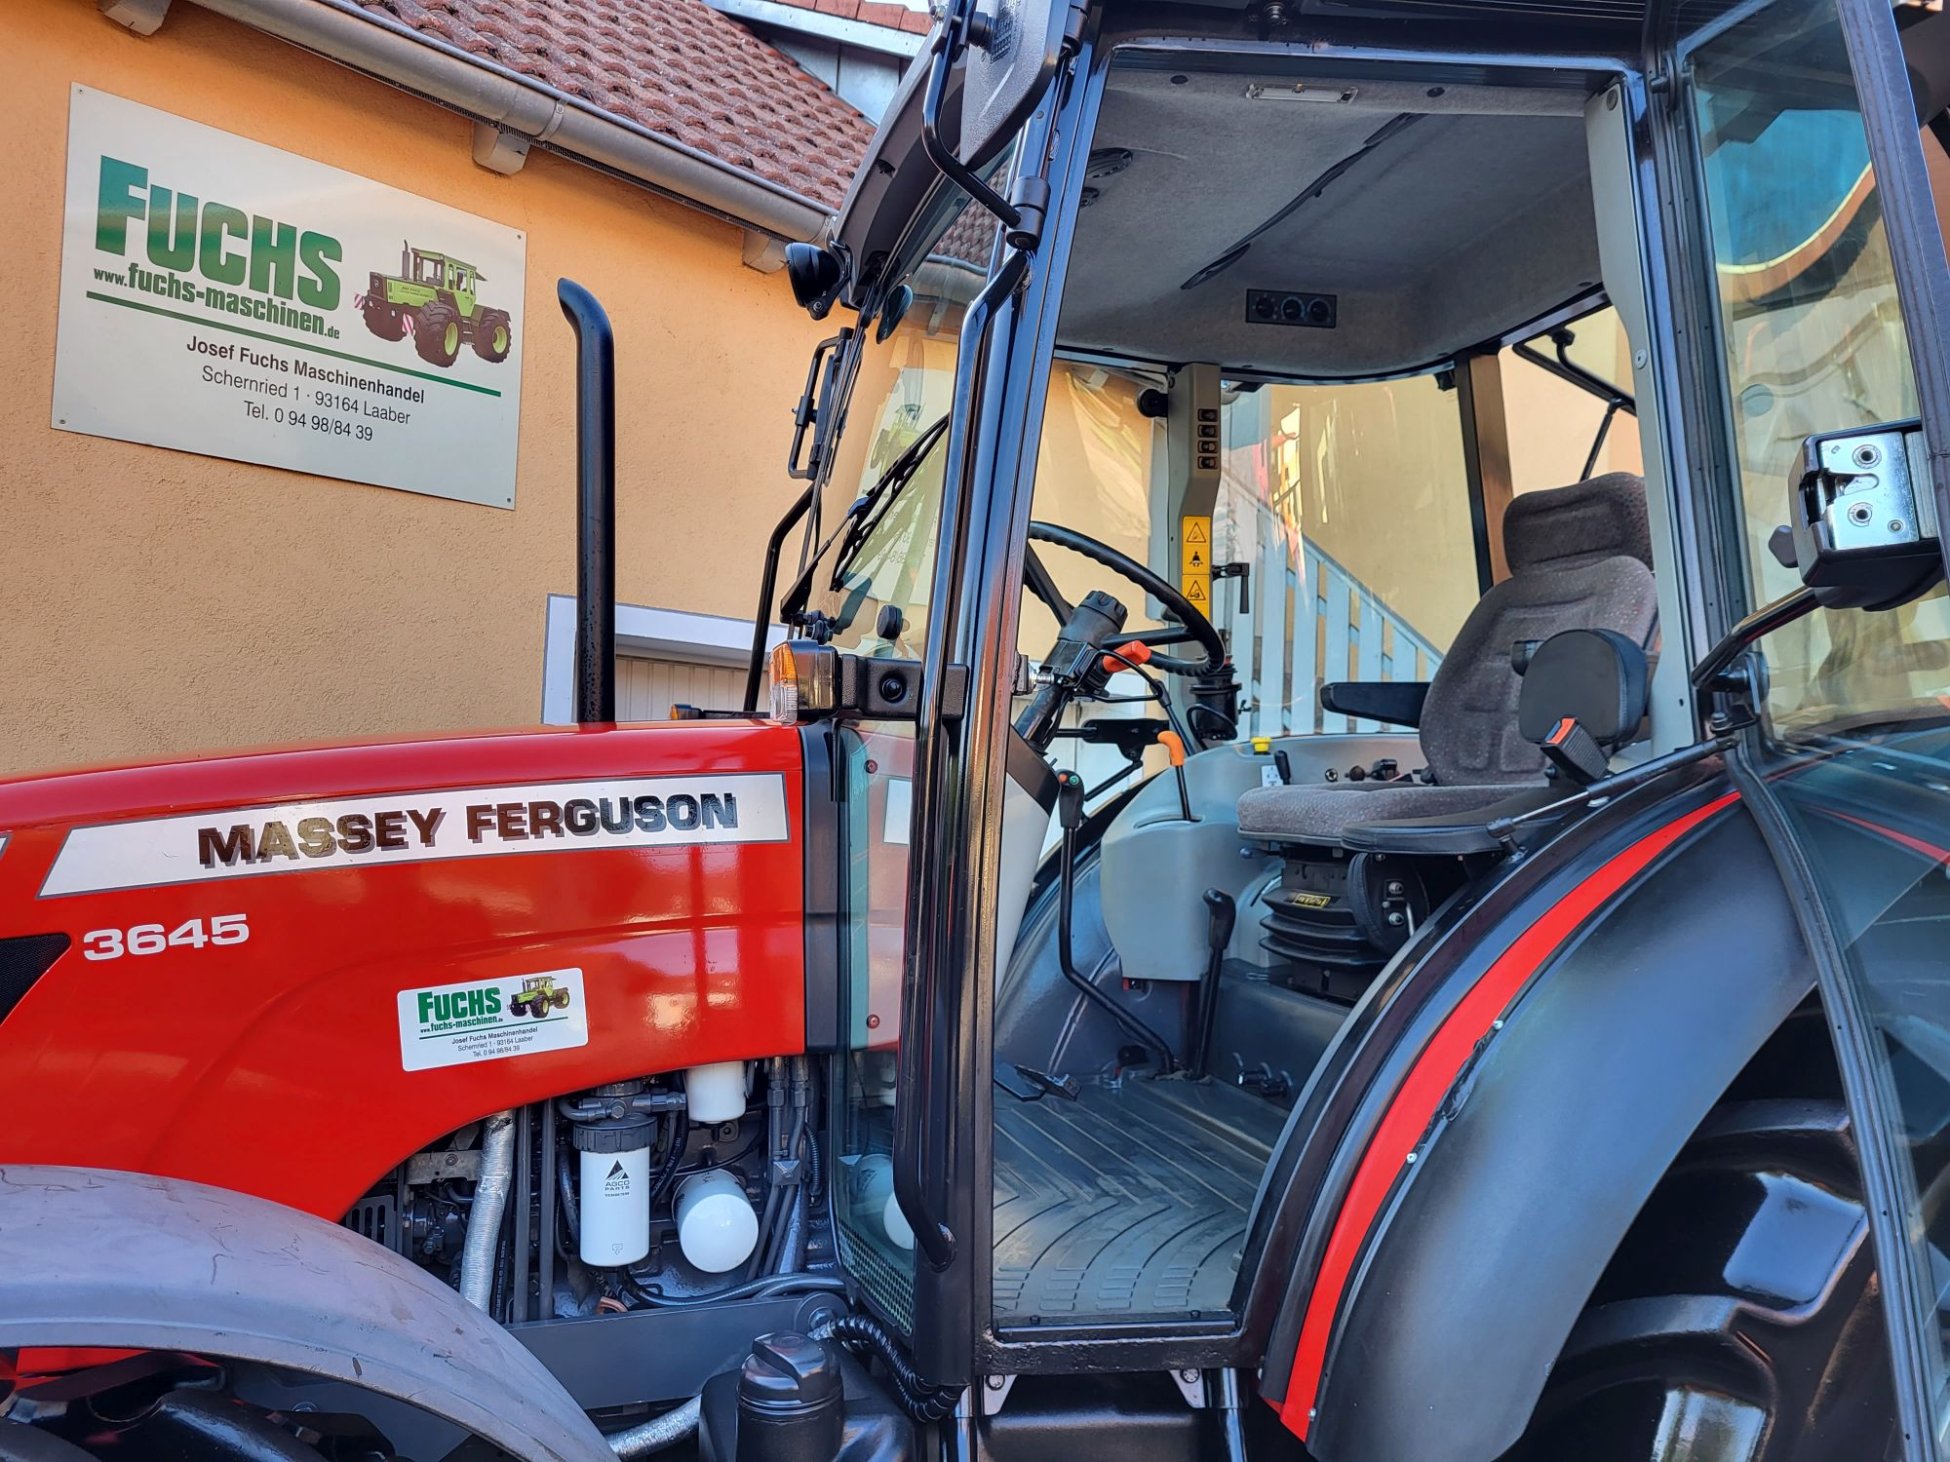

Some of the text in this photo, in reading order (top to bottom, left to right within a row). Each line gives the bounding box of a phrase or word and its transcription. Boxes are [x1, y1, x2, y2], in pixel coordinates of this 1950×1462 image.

[95, 154, 343, 312] FUCHS
[93, 262, 340, 340] www.fuchs-maschinen.de
[187, 336, 425, 404] Josef Fuchs Maschinenhandel
[202, 365, 411, 424] Schernried 1 93164 Laaber
[243, 400, 373, 441] Tel. 0 94 98/84 39
[199, 792, 739, 870] MASSEY FERGUSON
[83, 913, 250, 961] 3645
[417, 986, 502, 1024] FUCHS
[452, 1026, 538, 1045] Josef Fuchs Maschinenhandel
